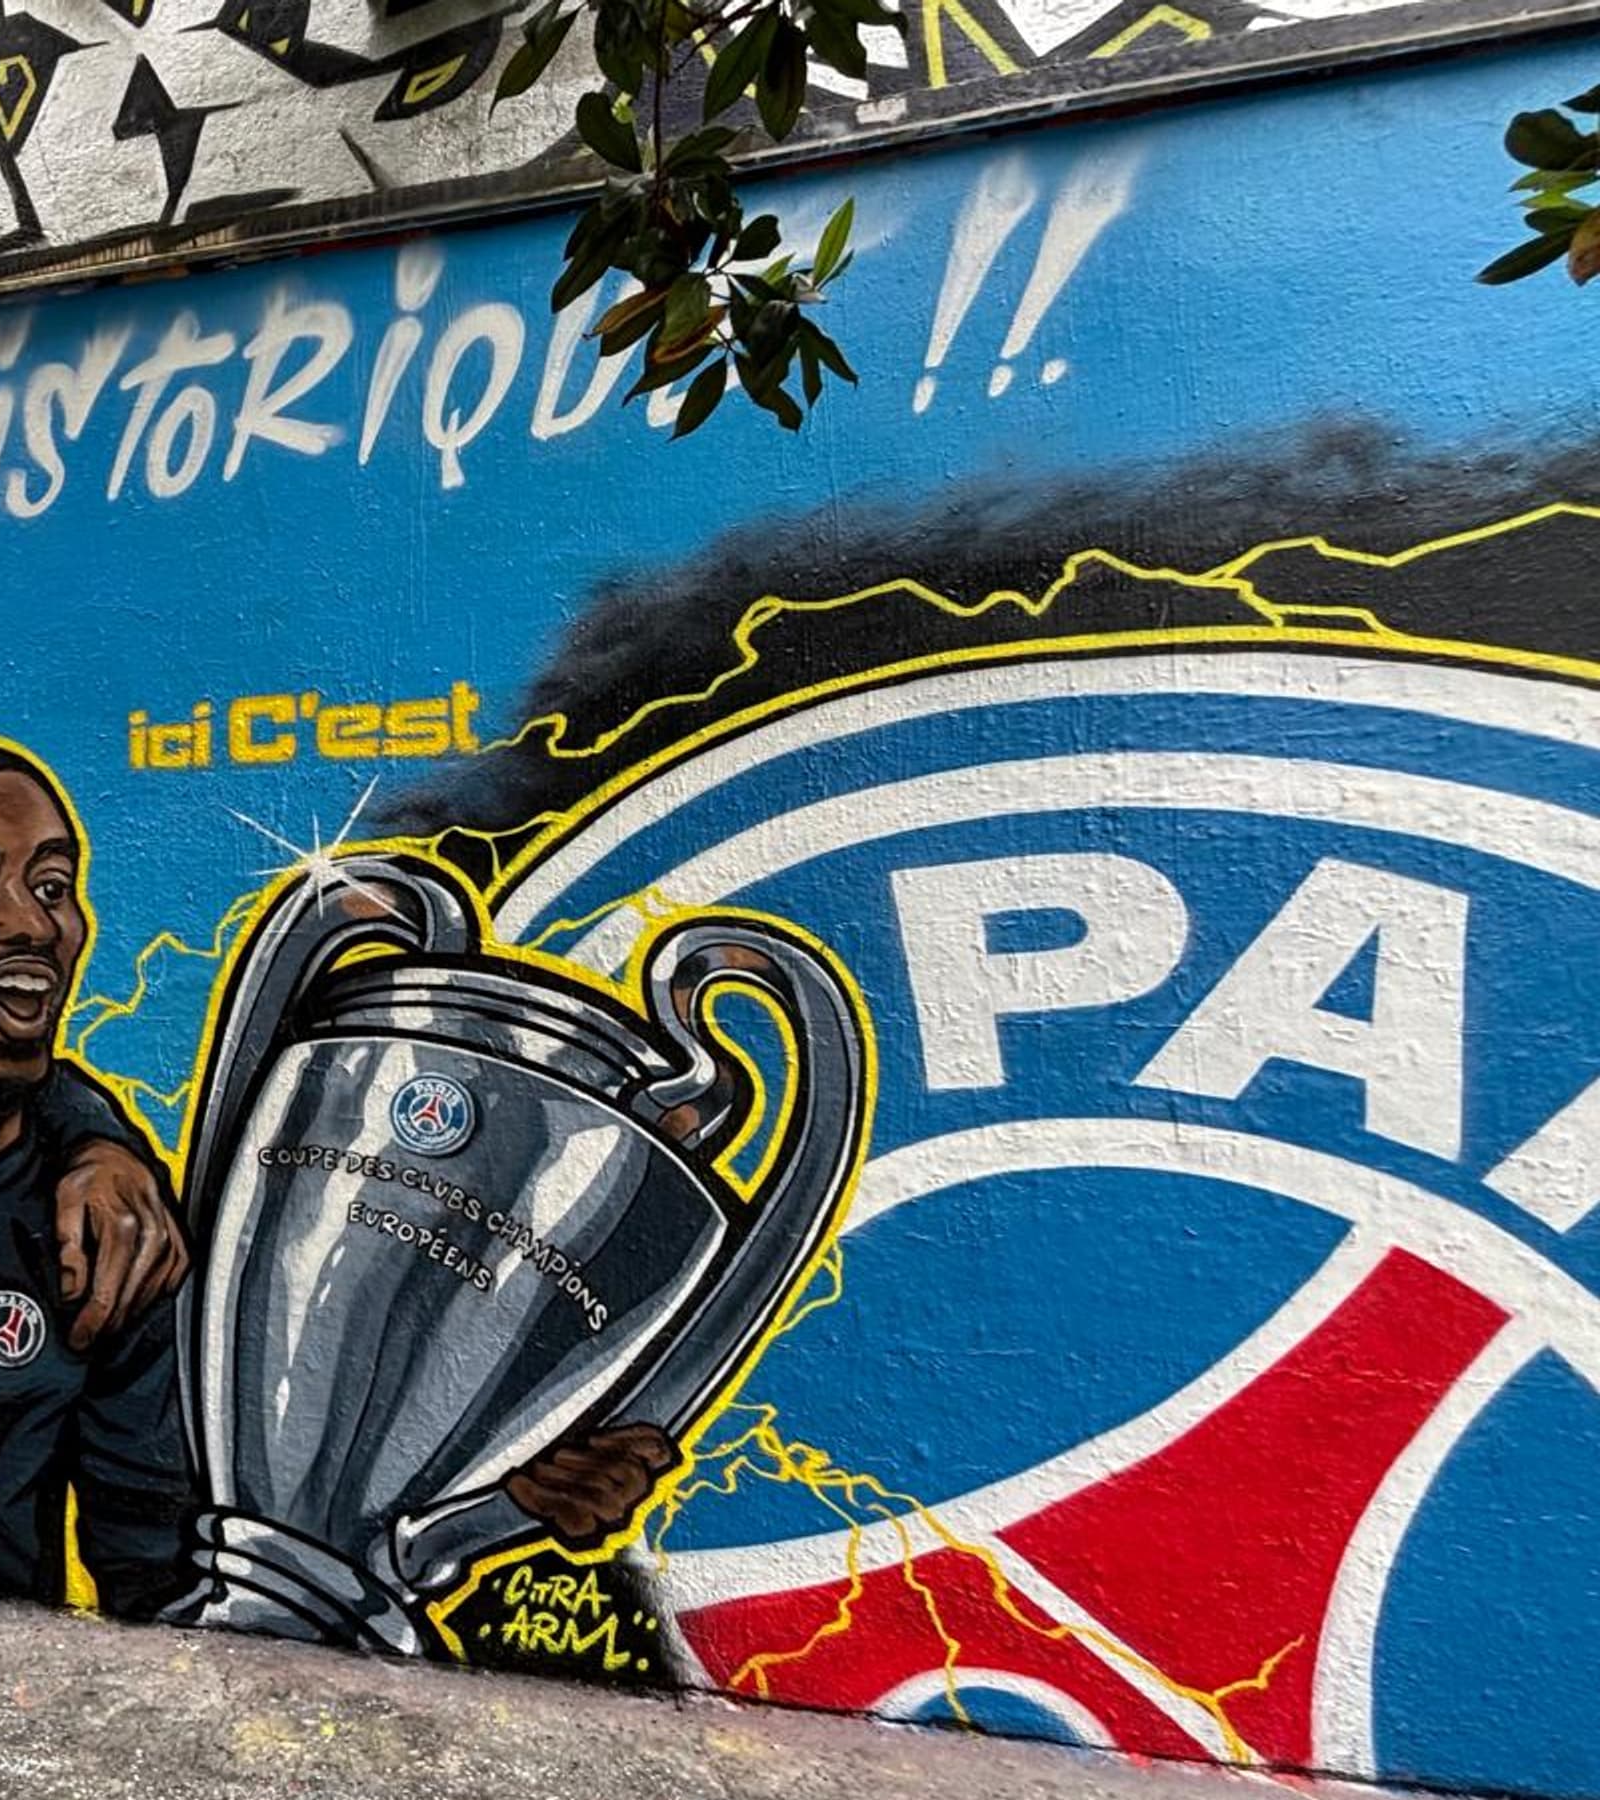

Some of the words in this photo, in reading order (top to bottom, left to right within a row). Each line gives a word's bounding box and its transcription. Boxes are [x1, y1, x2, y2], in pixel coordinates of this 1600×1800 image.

[128, 701, 212, 769] ici
[228, 680, 481, 765] C'est
[259, 1146, 339, 1171] COUPE
[347, 1151, 395, 1181] DES
[401, 1169, 483, 1223] CLUBS
[348, 1202, 493, 1290] EUROPÉENS
